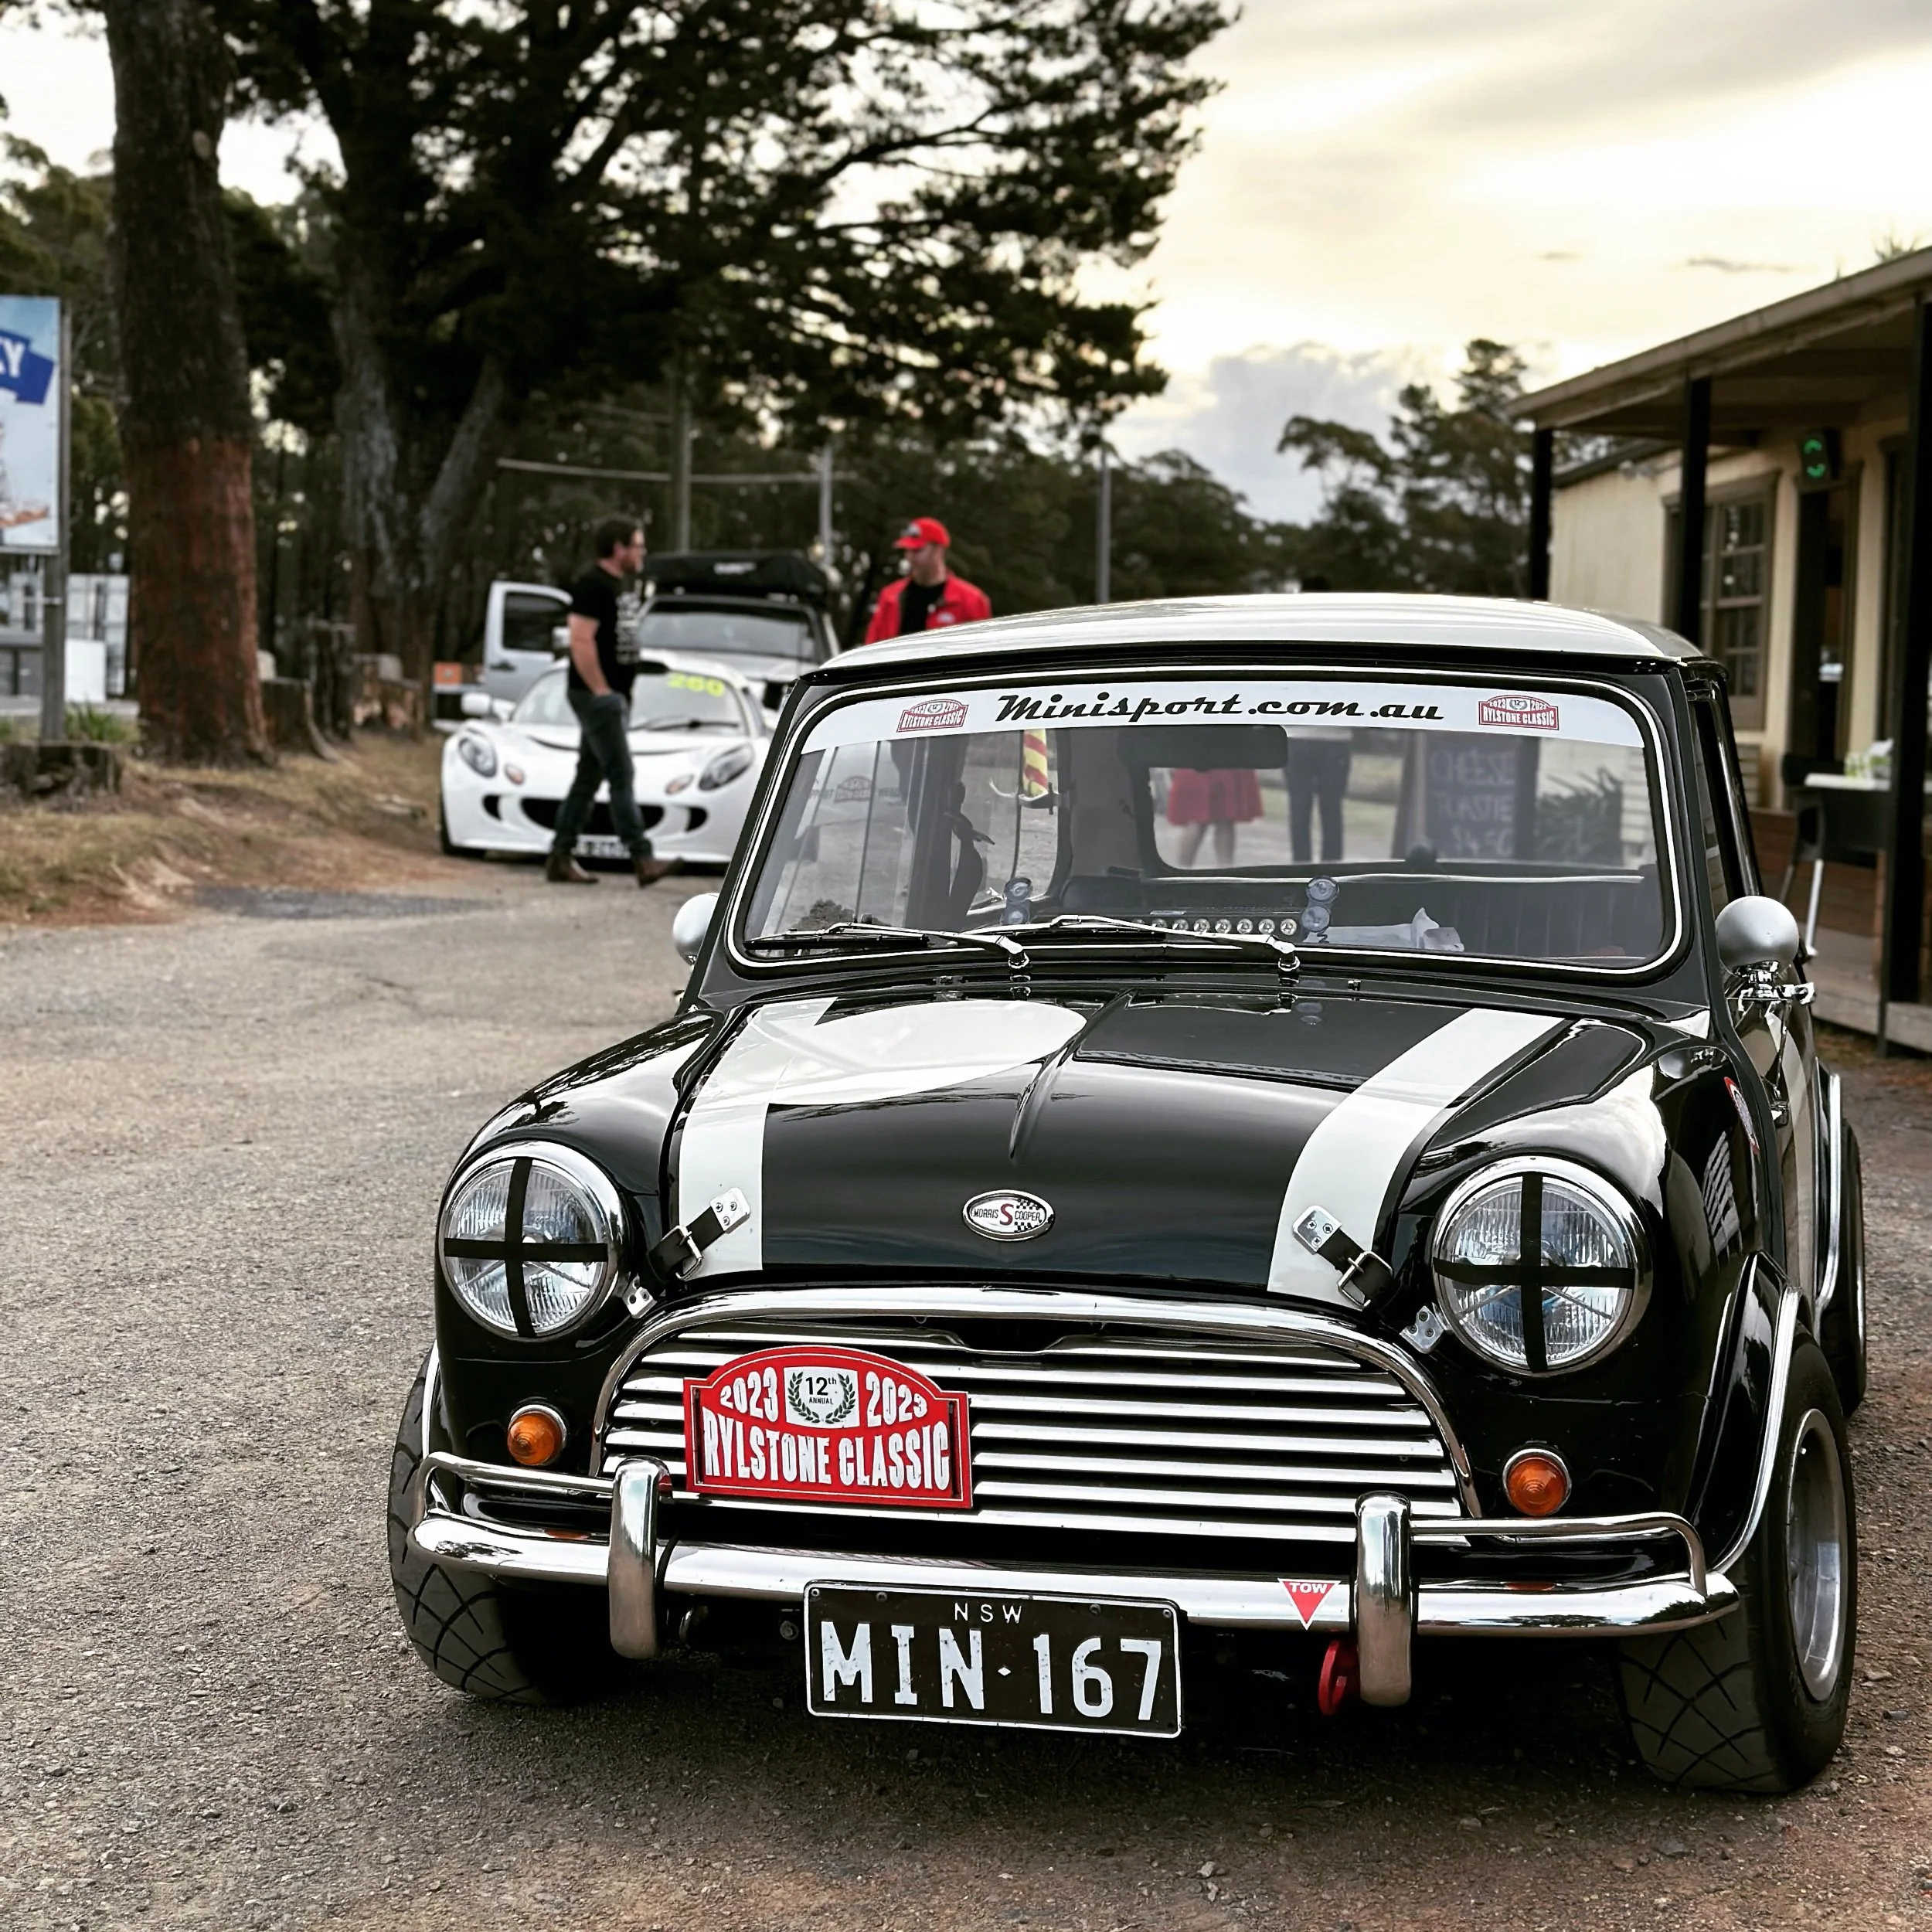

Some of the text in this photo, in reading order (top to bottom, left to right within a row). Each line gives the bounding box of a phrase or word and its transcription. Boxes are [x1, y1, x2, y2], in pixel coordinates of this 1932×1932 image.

[995, 692, 1444, 722] Minisport.com.au
[1483, 706, 1555, 726] RYLSTONE CLASSIC
[902, 709, 963, 728] RYLSTONE CLASSIC
[974, 1203, 1041, 1226] MORRIS S COOPER
[719, 1366, 779, 1422] 2023
[805, 1376, 837, 1396] 12th
[808, 1396, 834, 1405] ANNUAL
[866, 1370, 928, 1427] 2023
[702, 1406, 950, 1491] RYLSTONE CLASSIC
[1288, 1582, 1328, 1594] TOW
[954, 1602, 1022, 1624] NSW
